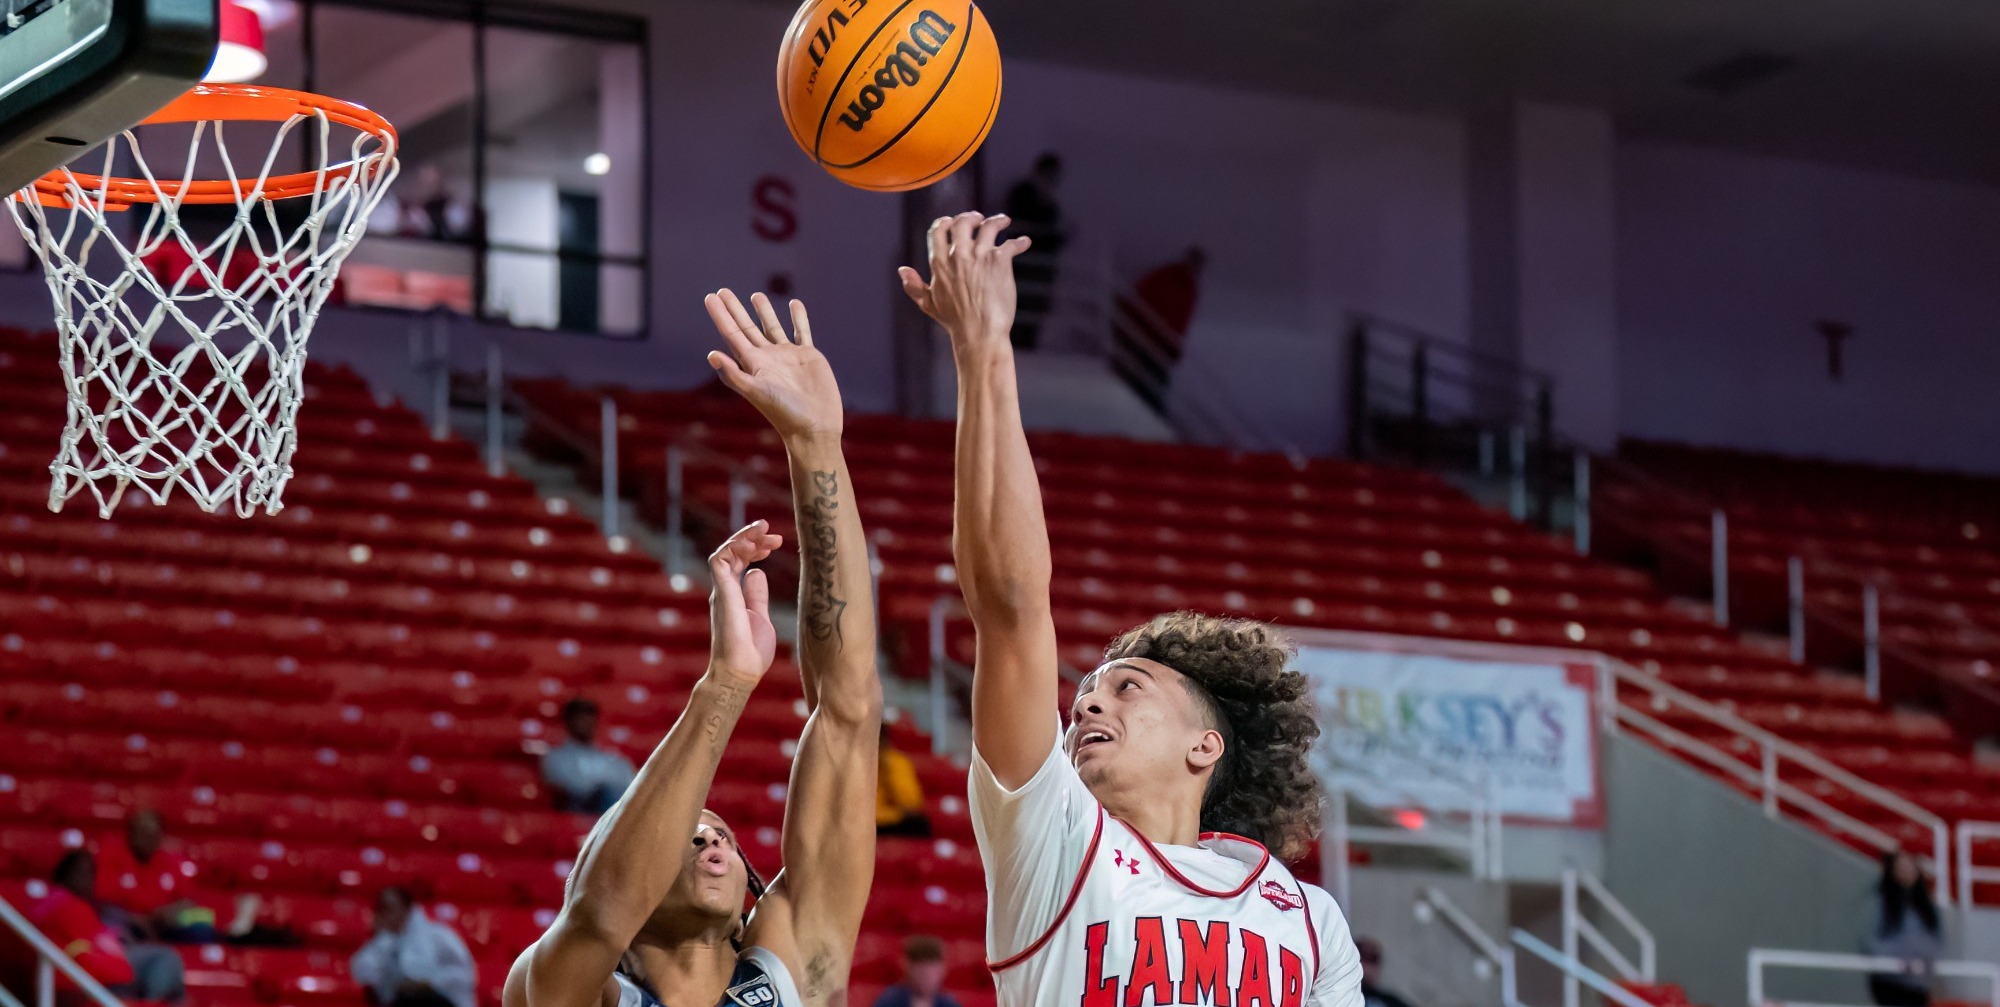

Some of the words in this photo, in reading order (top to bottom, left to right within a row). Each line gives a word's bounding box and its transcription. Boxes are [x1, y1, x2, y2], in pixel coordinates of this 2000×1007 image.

[837, 9, 956, 132] Wilson
[753, 174, 797, 243] S
[742, 986, 774, 1006] 60
